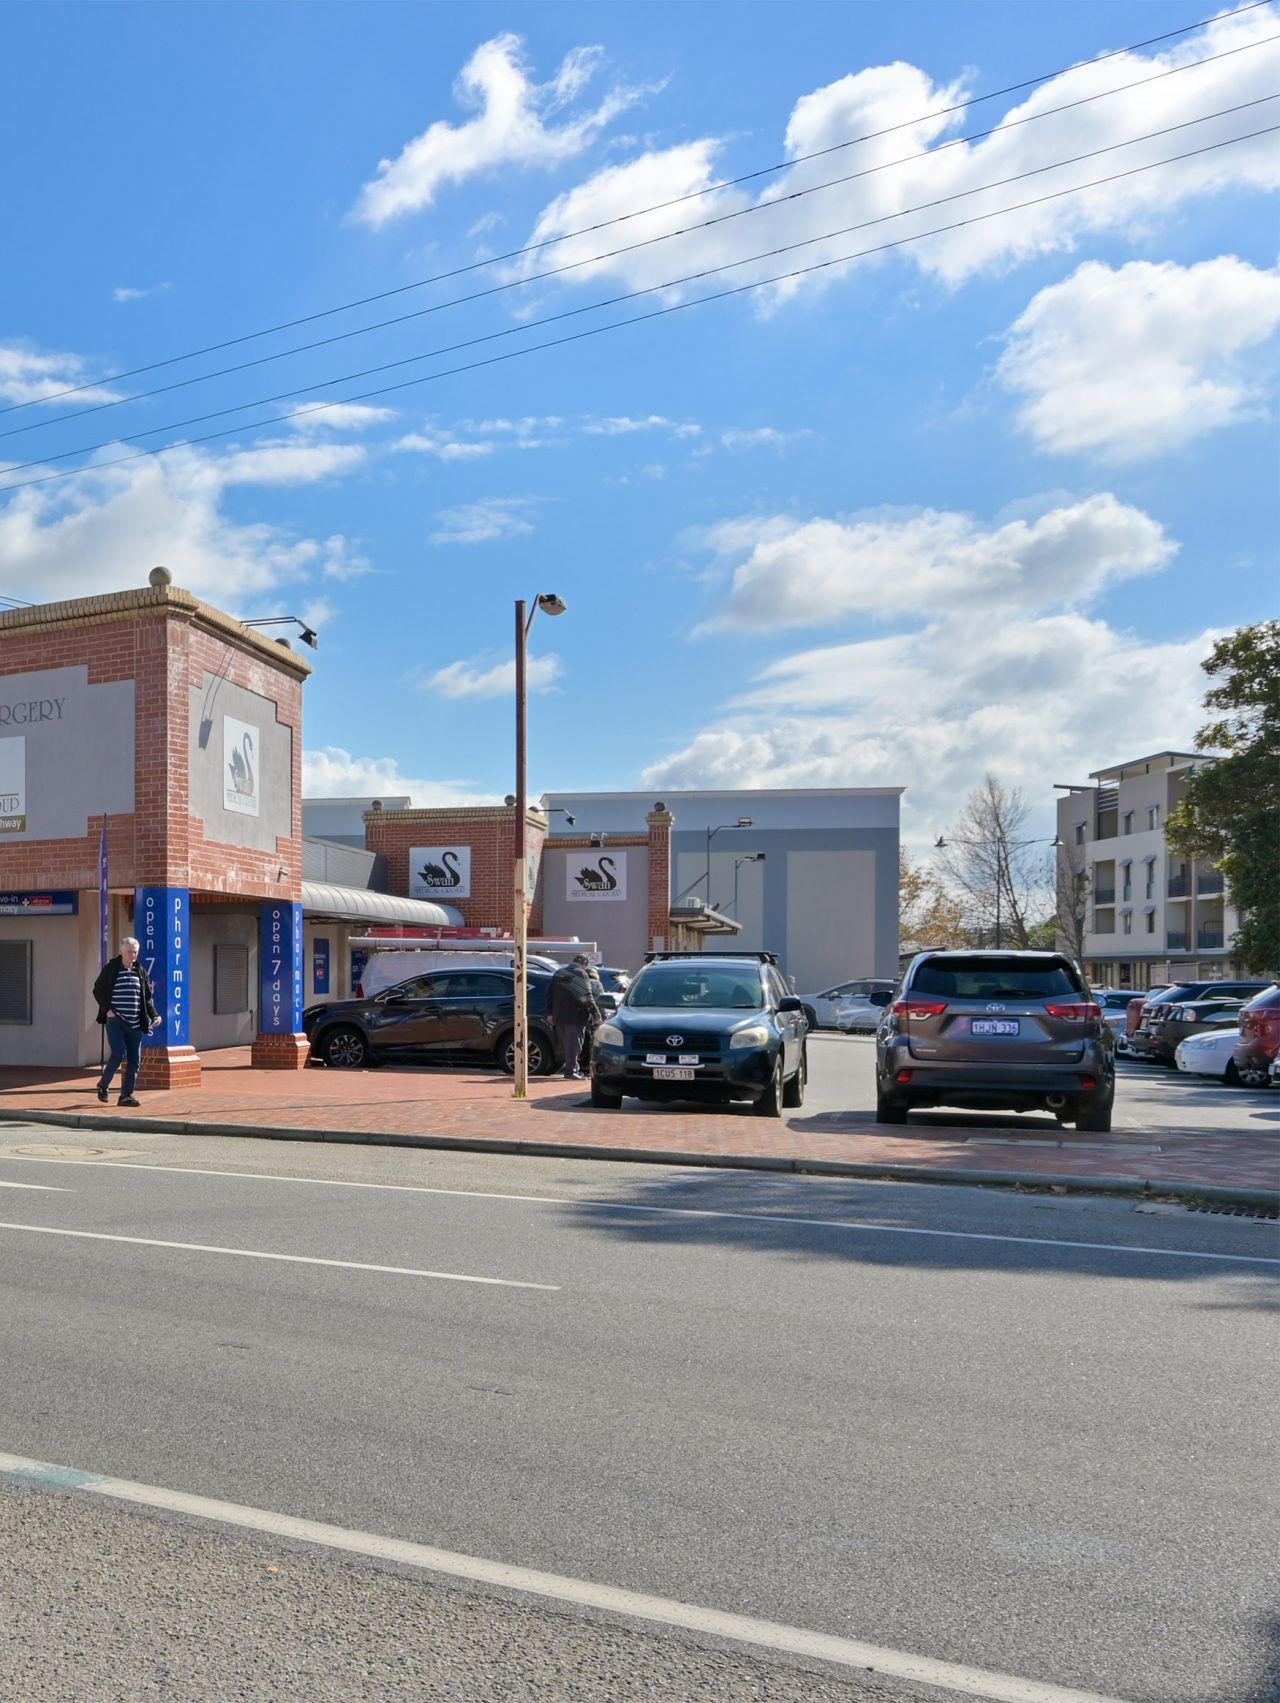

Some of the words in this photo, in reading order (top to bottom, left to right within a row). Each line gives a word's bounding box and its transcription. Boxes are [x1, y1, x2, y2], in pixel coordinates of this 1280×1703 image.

[425, 874, 454, 887] Swan
[583, 878, 611, 890] Swan
[146, 897, 155, 950] open
[272, 910, 281, 954] open
[145, 957, 156, 976] 7
[173, 898, 183, 1036] pharmacy
[271, 960, 281, 976] 7
[147, 980, 156, 1037] ds
